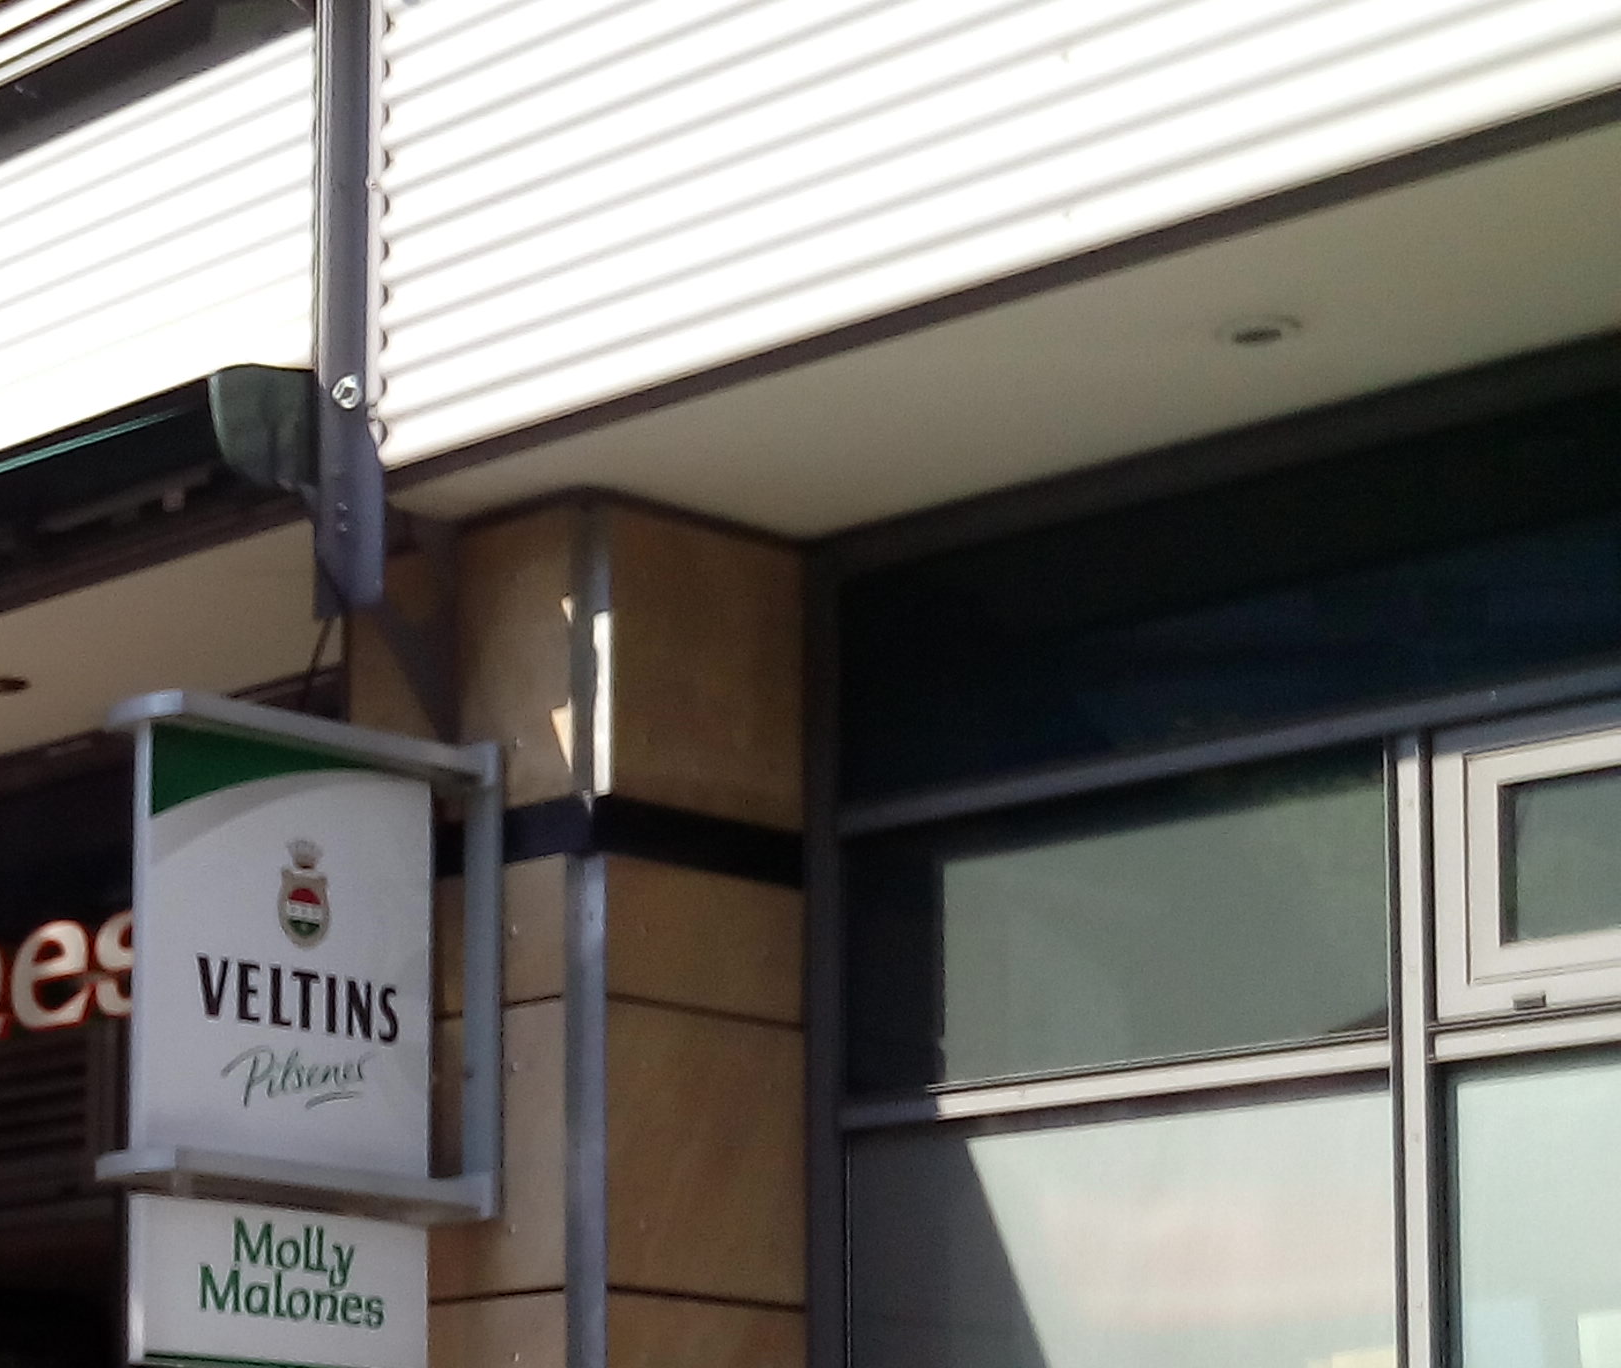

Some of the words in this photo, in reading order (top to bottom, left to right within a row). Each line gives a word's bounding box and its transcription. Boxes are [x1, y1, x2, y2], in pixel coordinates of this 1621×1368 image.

[195, 952, 399, 1045] VELTINS
[233, 1216, 355, 1289] Molly
[197, 1263, 385, 1329] Malones
